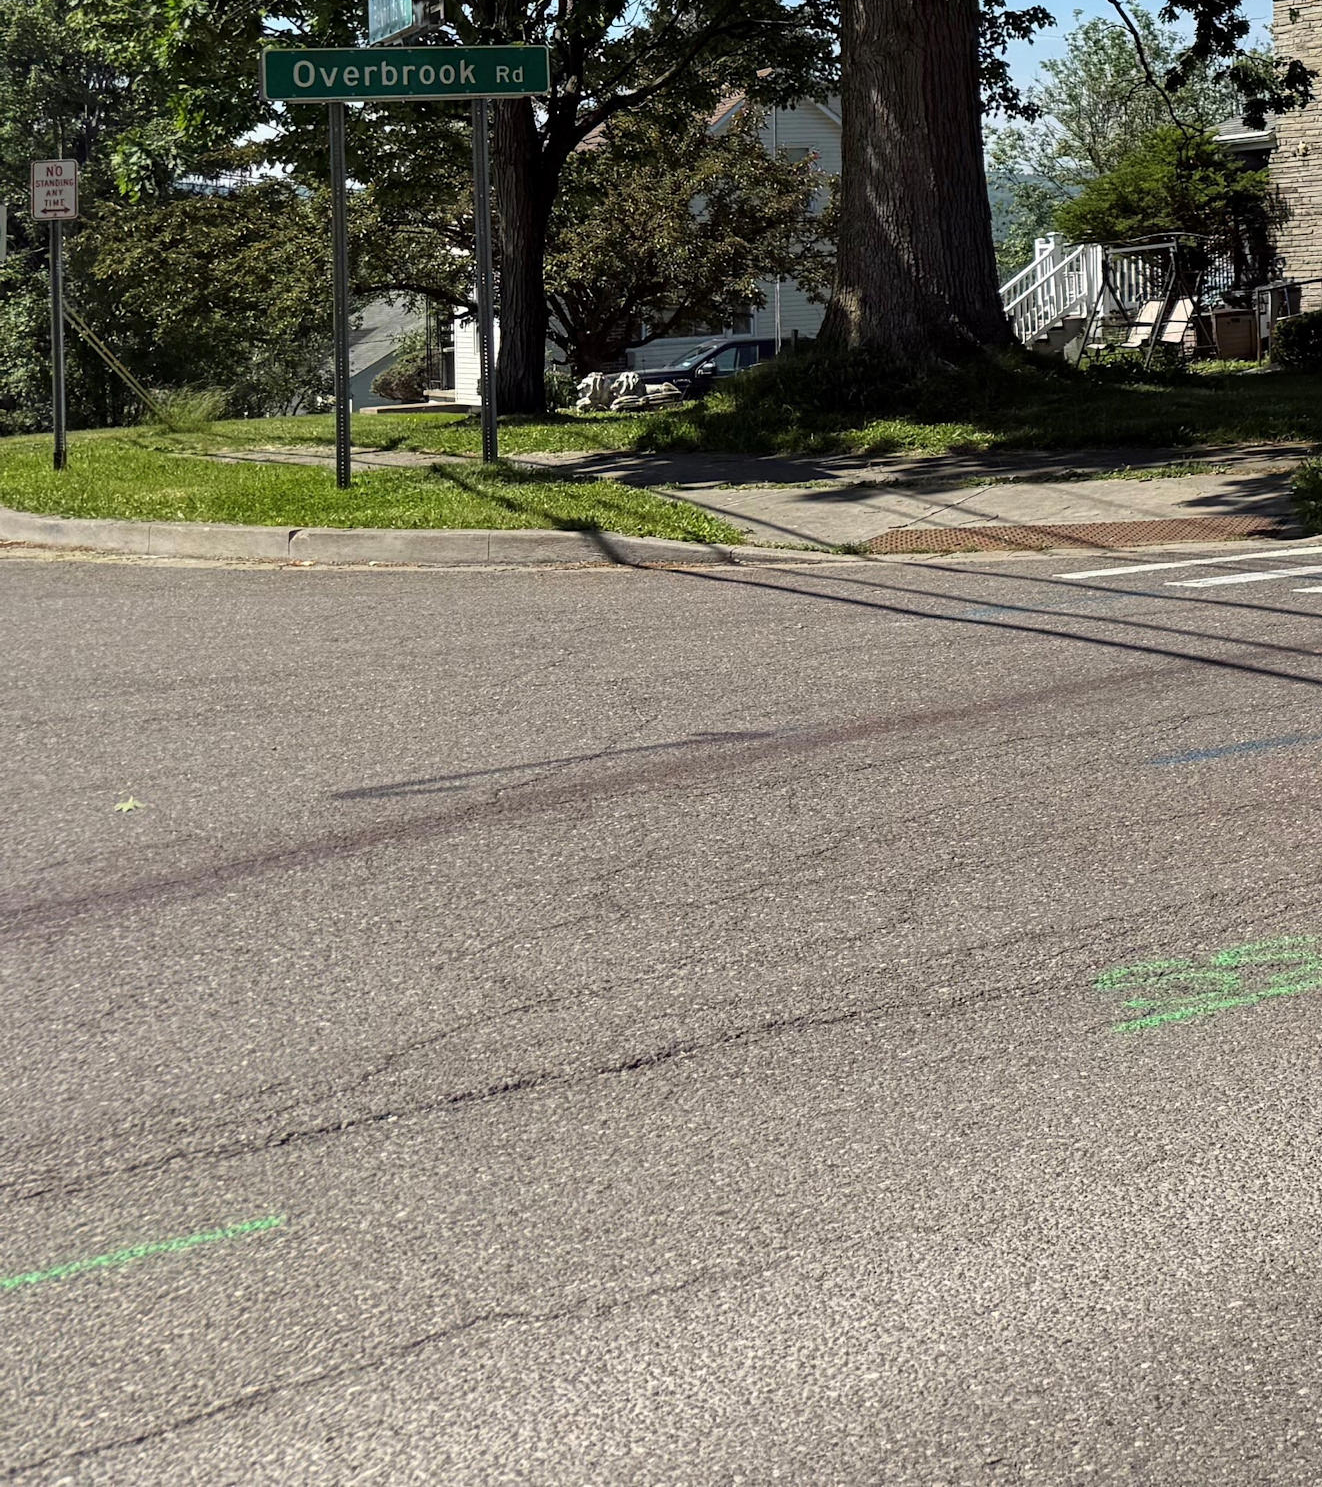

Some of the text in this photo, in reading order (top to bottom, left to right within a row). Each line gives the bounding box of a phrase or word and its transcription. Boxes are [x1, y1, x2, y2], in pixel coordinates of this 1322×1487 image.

[293, 60, 524, 88] Overbrook Rd
[46, 166, 63, 177] NO
[35, 179, 74, 188] STANDING
[46, 189, 64, 197] ANY
[44, 199, 65, 207] TIME
